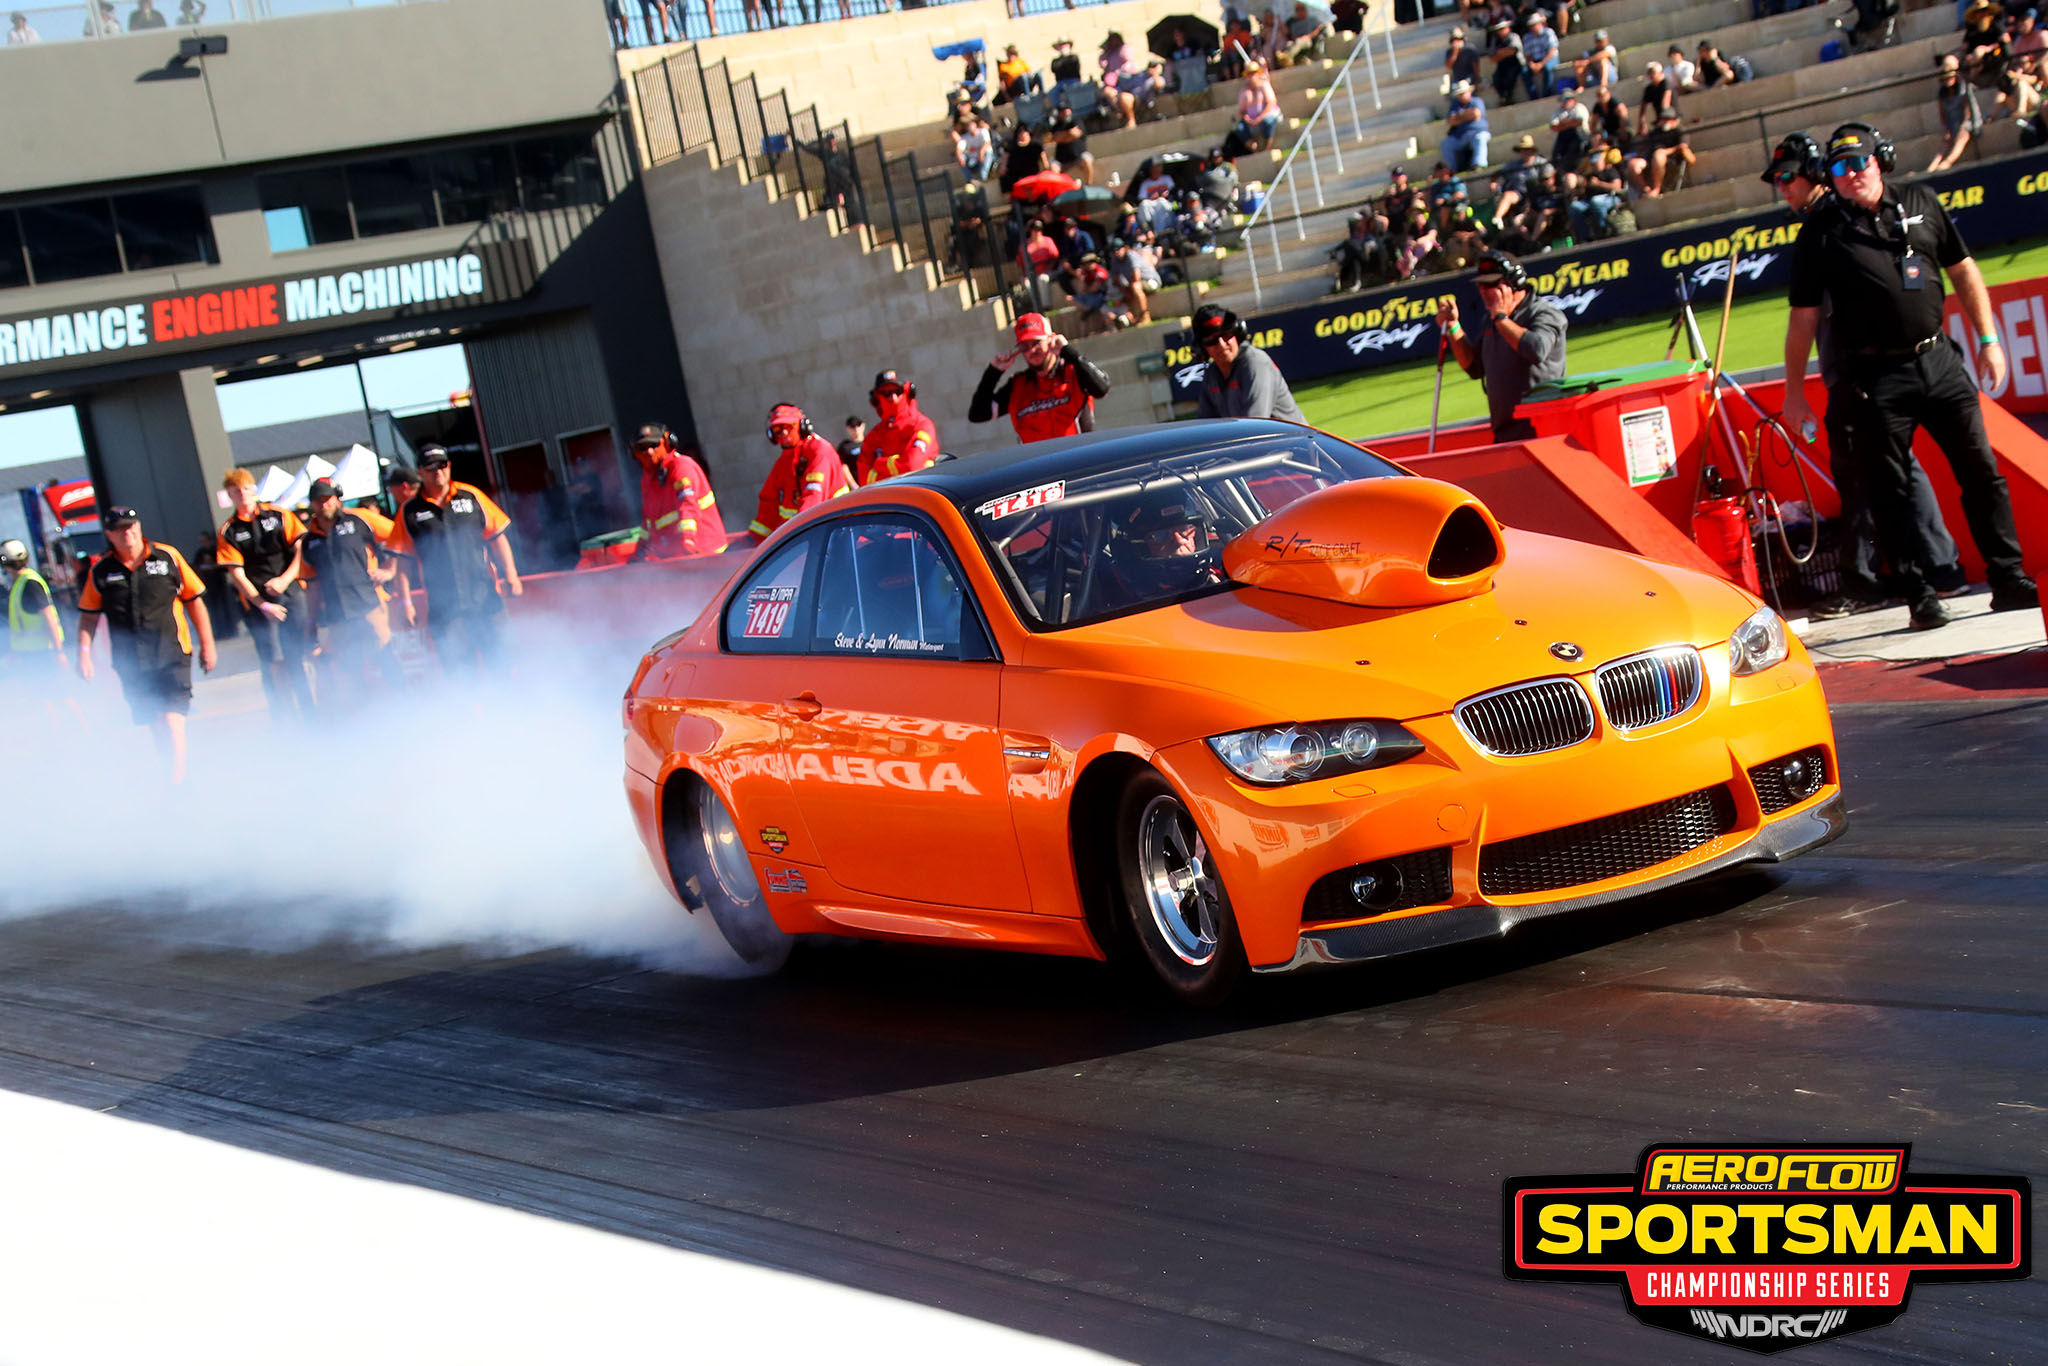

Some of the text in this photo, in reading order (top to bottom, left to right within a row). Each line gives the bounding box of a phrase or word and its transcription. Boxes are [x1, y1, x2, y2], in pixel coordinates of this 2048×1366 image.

[0, 254, 483, 366] RMANCE ENGINE MACHINING
[994, 485, 1062, 518] 1419
[1265, 532, 1311, 558] R/T
[748, 603, 788, 634] 1419
[835, 632, 854, 648] Steve
[855, 632, 864, 649] &
[888, 633, 918, 651] Norman
